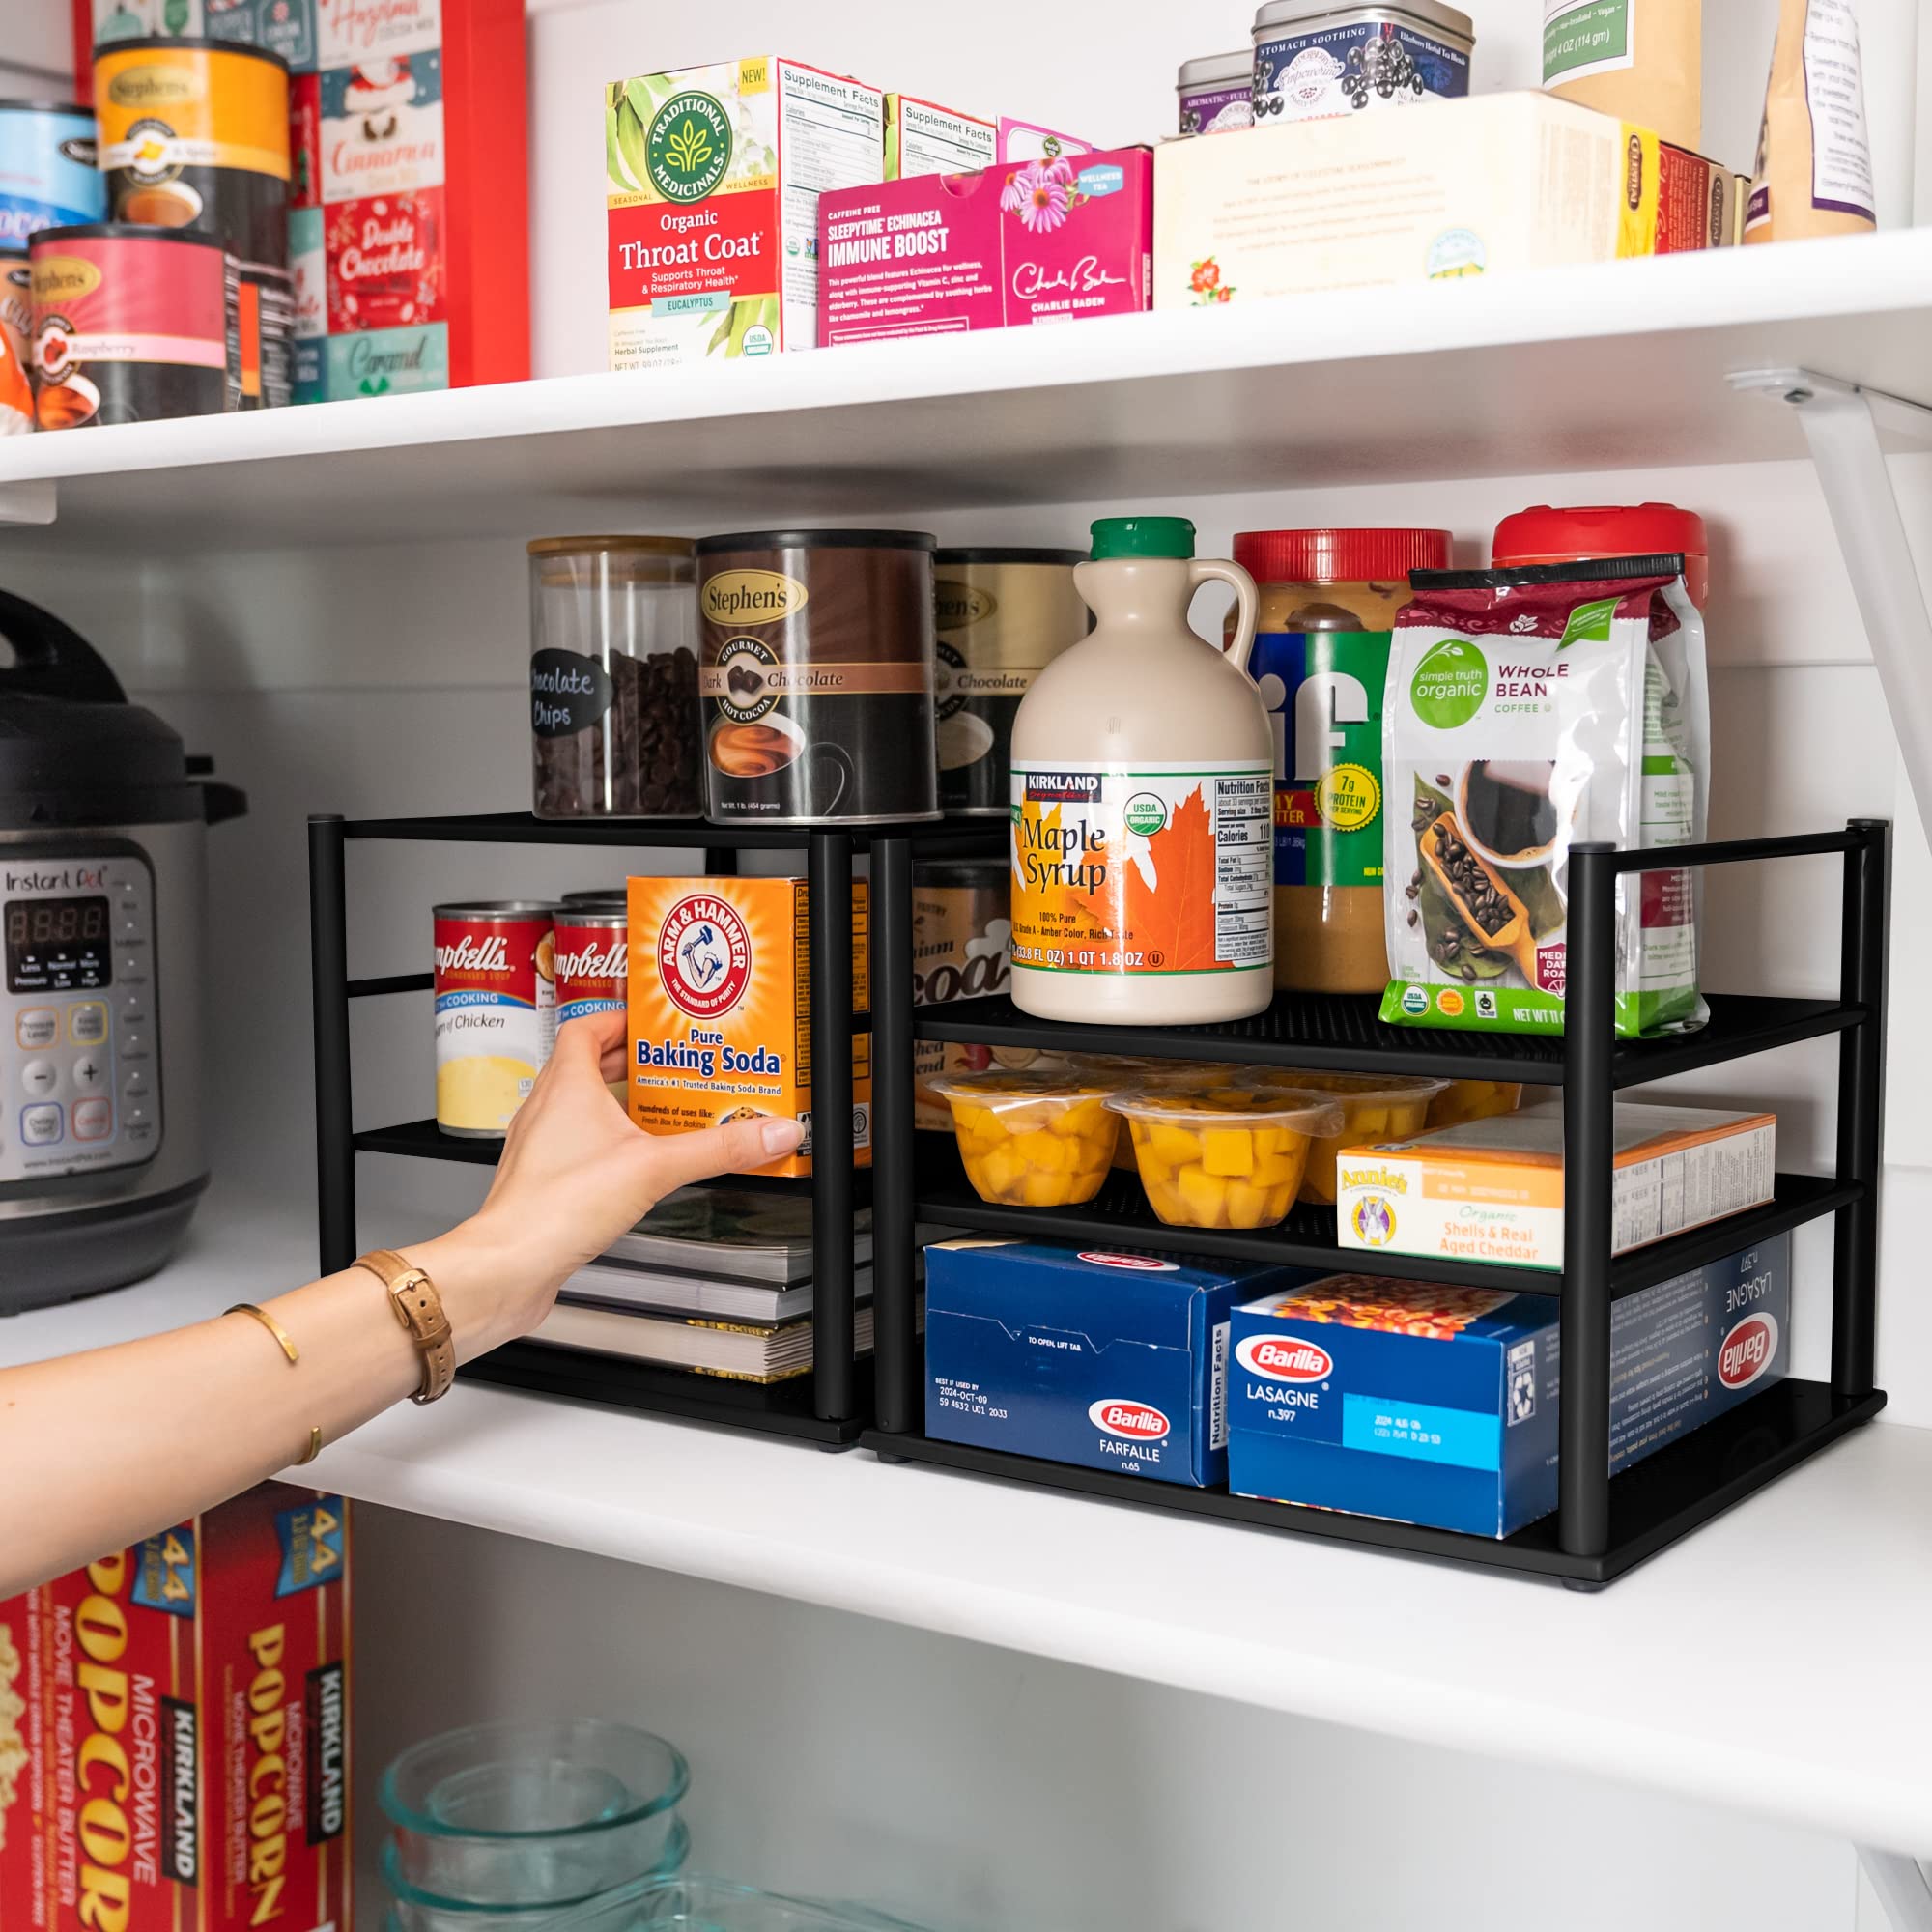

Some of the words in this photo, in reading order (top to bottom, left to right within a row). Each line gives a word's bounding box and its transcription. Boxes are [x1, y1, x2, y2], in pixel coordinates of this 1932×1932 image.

[1260, 39, 1307, 57] STOMACH
[1312, 27, 1367, 46] SOOTHING
[1400, 30, 1425, 50] Elderberry
[1425, 41, 1441, 55] Herbal
[1441, 47, 1451, 59] Tea
[1450, 51, 1466, 67] Blends
[1563, 38, 1574, 53] OZ
[1592, 27, 1610, 46] gm)
[741, 67, 766, 85] NEW!
[784, 69, 847, 99] Supplement
[852, 90, 880, 108] Facts
[1186, 94, 1225, 108] AROMATIC
[652, 98, 725, 146] TRADITIONAL
[905, 106, 962, 135] Supplement
[965, 126, 992, 143] Facts
[653, 156, 724, 197] MEDICINALS
[726, 179, 768, 190] WELLNESS
[1079, 172, 1122, 184] WELLNESS
[1093, 183, 1108, 191] TEA
[614, 195, 653, 205] SEASONAL
[1712, 180, 1722, 240] CELESTIAL
[660, 210, 718, 234] Organic
[828, 208, 862, 221] CAFFEINE
[863, 205, 881, 215] FREE
[362, 217, 414, 250] Double
[828, 218, 884, 241] SLEEPYTIME
[887, 210, 942, 232] ECHINACEA
[619, 239, 699, 270] Throat
[704, 233, 760, 261] Coat
[828, 236, 891, 268] IMMUNE
[895, 228, 950, 258] BOOST
[339, 244, 425, 280] Chocolate
[641, 285, 649, 294] &
[651, 278, 703, 293] Respiratory
[652, 270, 694, 286] Supports
[696, 266, 725, 277] Throat
[828, 277, 840, 287] This
[828, 290, 844, 299] along
[844, 288, 858, 297] with
[965, 273, 979, 283] and
[668, 297, 713, 311] EUCALYPTUS
[934, 290, 944, 299] by
[1031, 299, 1071, 313] CHARLIE
[1072, 297, 1105, 309] BADEN
[828, 314, 839, 323] like
[871, 308, 884, 317] and
[614, 346, 638, 356] Herbal
[638, 344, 679, 356] Supplement
[708, 582, 788, 615] Stephen's
[722, 640, 769, 663] GOURMET
[957, 673, 1028, 689] Chocolate
[1419, 670, 1454, 683] simple
[1455, 668, 1483, 681] truth
[1497, 664, 1570, 679] WHOLE
[1416, 681, 1483, 700] organic
[1495, 682, 1548, 697] BEAN
[533, 700, 572, 731] Chips
[722, 698, 740, 720] HOT
[739, 699, 772, 721] COCOA
[1494, 703, 1539, 714] COFFEE
[1028, 775, 1099, 791] KIRKLAND
[1217, 781, 1254, 795] Nutrition
[1341, 776, 1355, 793] 7g
[1133, 803, 1157, 813] USDA
[1129, 815, 1161, 825] ORGANIC
[1022, 818, 1106, 860] Maple
[1217, 830, 1249, 842] Calories
[6, 870, 71, 891] Instant
[76, 867, 103, 890] Pot
[1026, 853, 1107, 895] Syrup
[1038, 911, 1057, 923] 100%
[1059, 913, 1076, 923] Pure
[663, 919, 683, 967] ARM
[679, 907, 694, 925] &
[694, 900, 746, 969] HAMMER
[1040, 926, 1062, 938] Amber
[1064, 928, 1087, 940] Color,
[1089, 928, 1108, 940] Rich
[1016, 945, 1033, 960] (33.8
[1034, 948, 1044, 962] FL
[1046, 949, 1065, 966] OZ)
[1067, 951, 1074, 964] 1
[1078, 951, 1096, 967] QT
[1099, 951, 1121, 966] 1.8
[1124, 952, 1144, 966] OZ
[54, 978, 71, 989] Low
[81, 976, 100, 987] High
[446, 992, 498, 1007] COOKING
[671, 977, 682, 994] THE
[679, 988, 710, 1009] STANDARD
[710, 996, 719, 1007] OF
[718, 980, 737, 1004] PURITY
[570, 1001, 626, 1017] COOKING
[1513, 1008, 1531, 1022] NET
[1532, 1009, 1550, 1023] WT
[454, 1013, 505, 1030] Chicken
[691, 1029, 724, 1045] Pure
[637, 1040, 715, 1077] Baking
[722, 1045, 781, 1075] Soda
[637, 1076, 669, 1087] America's
[682, 1081, 709, 1091] Trusted
[710, 1082, 736, 1094] Baking
[737, 1084, 756, 1094] Soda
[758, 1085, 781, 1096] Brand
[638, 1104, 674, 1116] Hundreds
[681, 1108, 697, 1117] uses
[698, 1108, 715, 1119] like:
[642, 1115, 659, 1125] Fresh
[660, 1117, 671, 1126] Box
[674, 1117, 683, 1126] for
[1341, 1165, 1408, 1195] Annie's
[1459, 1205, 1518, 1225] Organic
[1444, 1221, 1485, 1237] Shells
[1488, 1226, 1497, 1238] &
[1501, 1227, 1534, 1241] Real
[1439, 1237, 1475, 1255] Aged
[1479, 1239, 1539, 1260] Cheddar
[1725, 1271, 1773, 1313] LASAGNE
[1028, 1336, 1037, 1345] TO
[1037, 1337, 1056, 1348] OPEN,
[1056, 1340, 1069, 1350] LIFT
[1213, 1329, 1222, 1373] Facts
[1257, 1344, 1325, 1373] Barilla
[1723, 1331, 1766, 1378] Barilla
[955, 1380, 971, 1390] USED
[939, 1387, 988, 1405] 2024-OCT-09
[939, 1397, 950, 1406] 59
[1246, 1383, 1319, 1409] LASAGNE
[1106, 1407, 1164, 1432] Barilla
[1212, 1376, 1222, 1444] Nutrition
[1267, 1408, 1296, 1423] n.397
[1098, 1439, 1161, 1463] FARFALLE
[1121, 1461, 1141, 1472] n.65
[310, 1508, 338, 1575] 44
[162, 1533, 190, 1604] 44
[54, 1605, 73, 1687] MOVIE
[55, 1693, 76, 1804] THEATER
[321, 1669, 343, 1833] KIRKLAND
[132, 1673, 157, 1887] MICROWAVE
[249, 1623, 287, 1927] POPCORN
[175, 1709, 196, 1878] KIRKLAND
[57, 1807, 77, 1907] BUTTER
